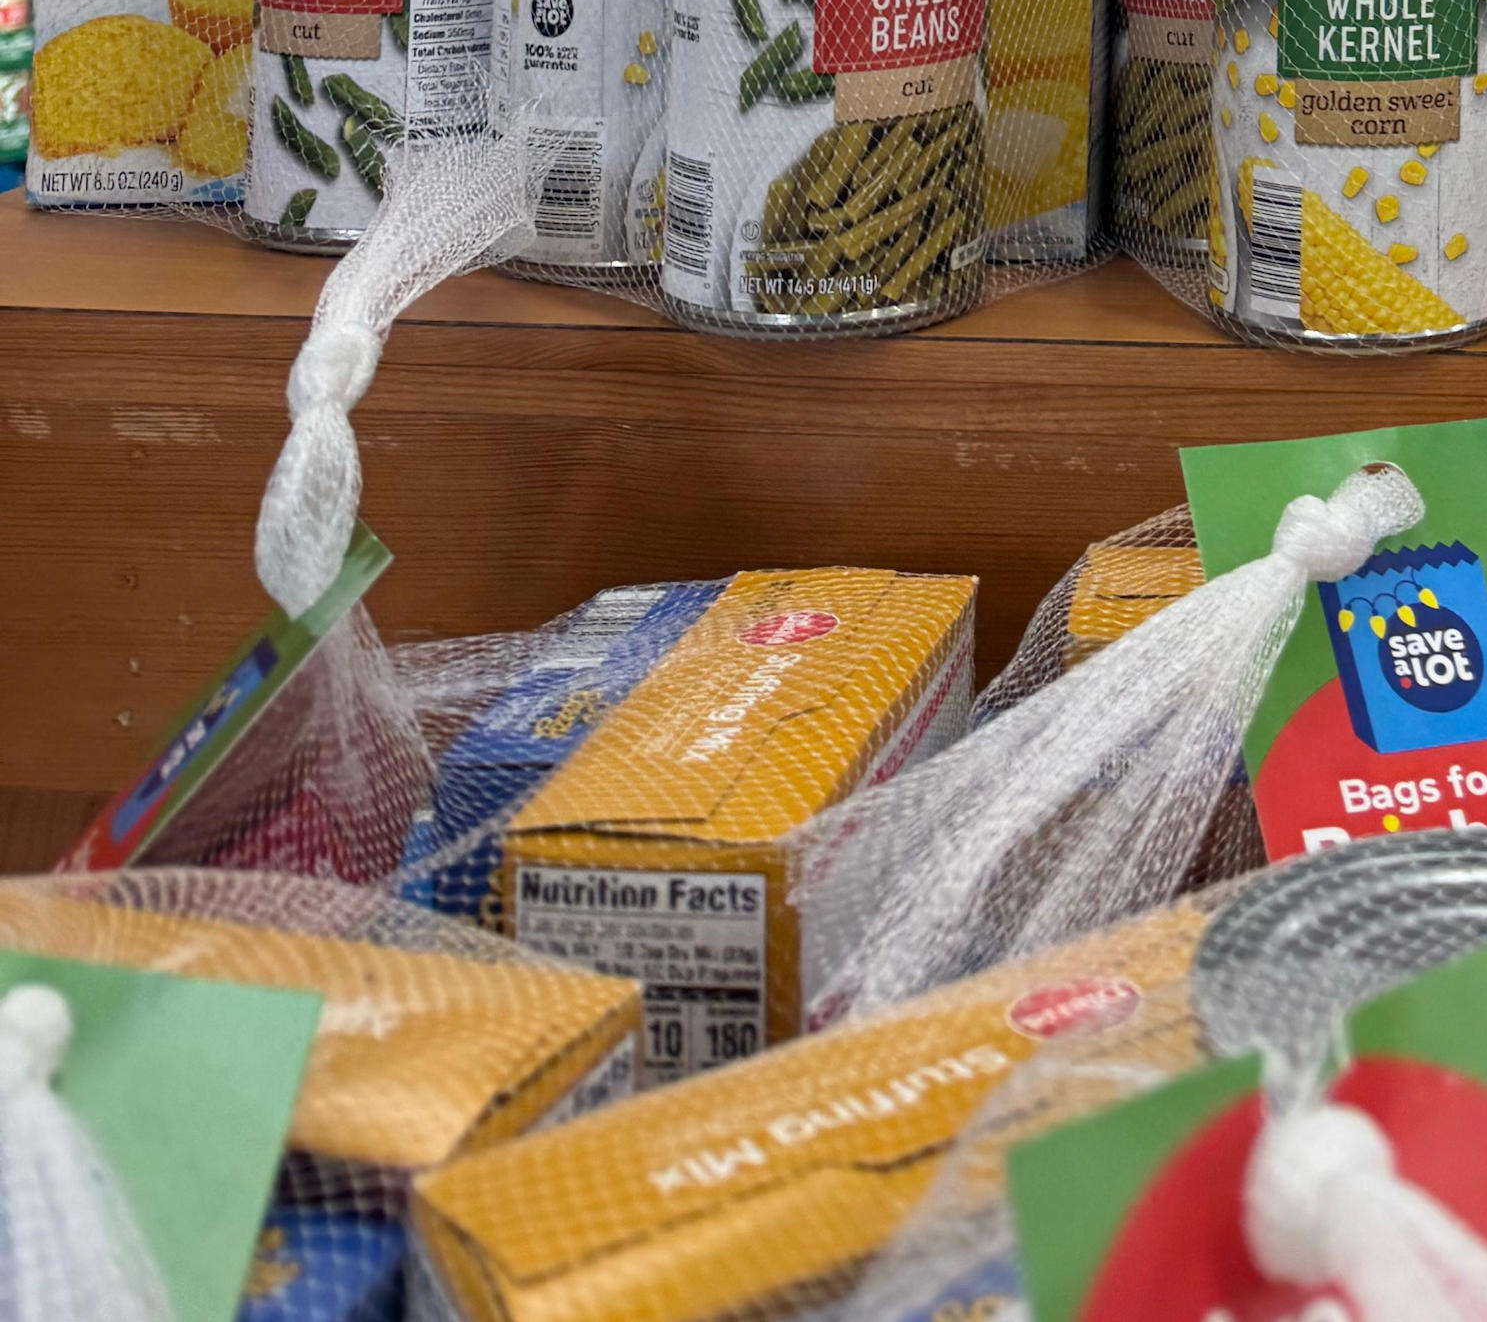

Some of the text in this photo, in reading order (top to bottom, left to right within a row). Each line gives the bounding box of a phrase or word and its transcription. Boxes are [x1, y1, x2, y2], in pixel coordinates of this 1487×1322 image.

[293, 21, 322, 42] cut
[873, 6, 960, 53] BEANS
[1318, 24, 1441, 63] KERNEL
[901, 74, 934, 98] cut
[1301, 87, 1456, 118] golden sweet
[1351, 110, 1408, 135] corn
[1388, 625, 1466, 659] save
[1339, 777, 1442, 814] Bags
[520, 871, 759, 913] Nutrition Facts
[649, 1044, 1010, 1196] Stuffing Mix
